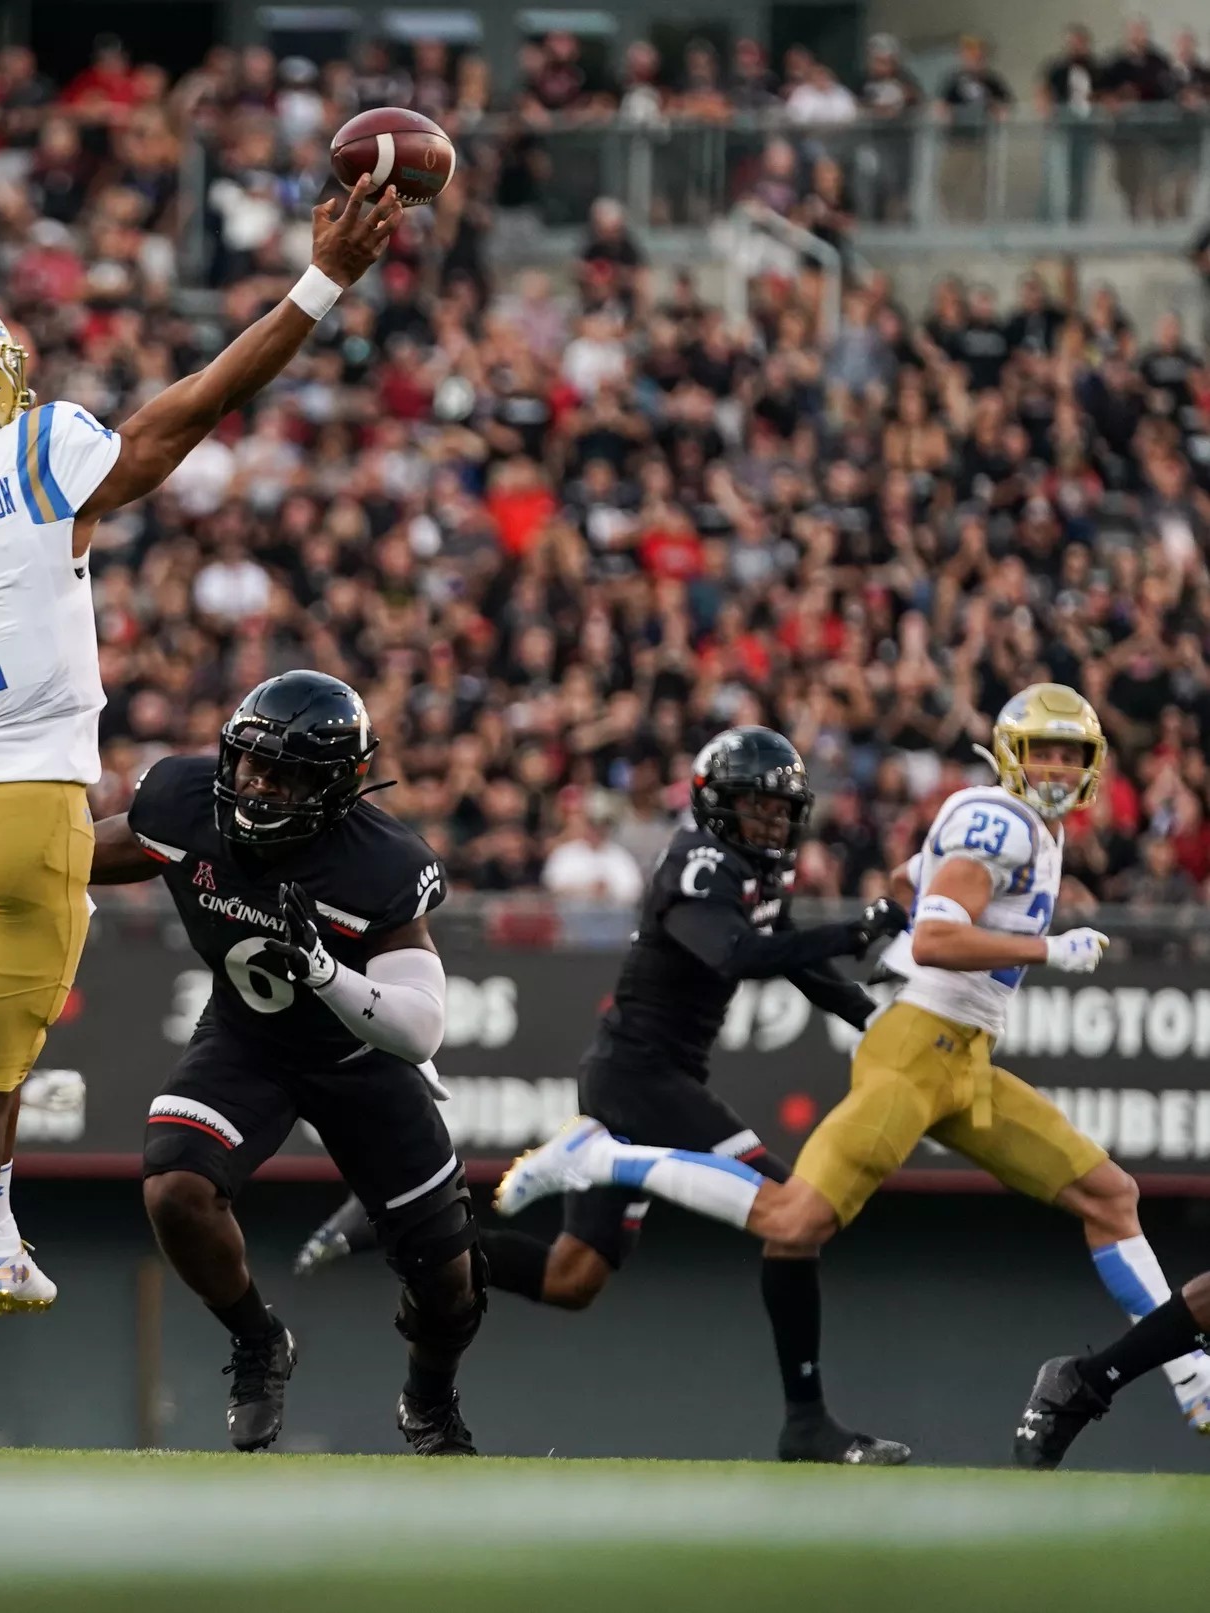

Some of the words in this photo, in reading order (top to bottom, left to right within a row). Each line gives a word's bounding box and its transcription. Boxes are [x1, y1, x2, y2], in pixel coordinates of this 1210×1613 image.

[964, 808, 1010, 857] 23
[198, 892, 287, 932] CINCINNAT
[225, 936, 295, 1014] 6
